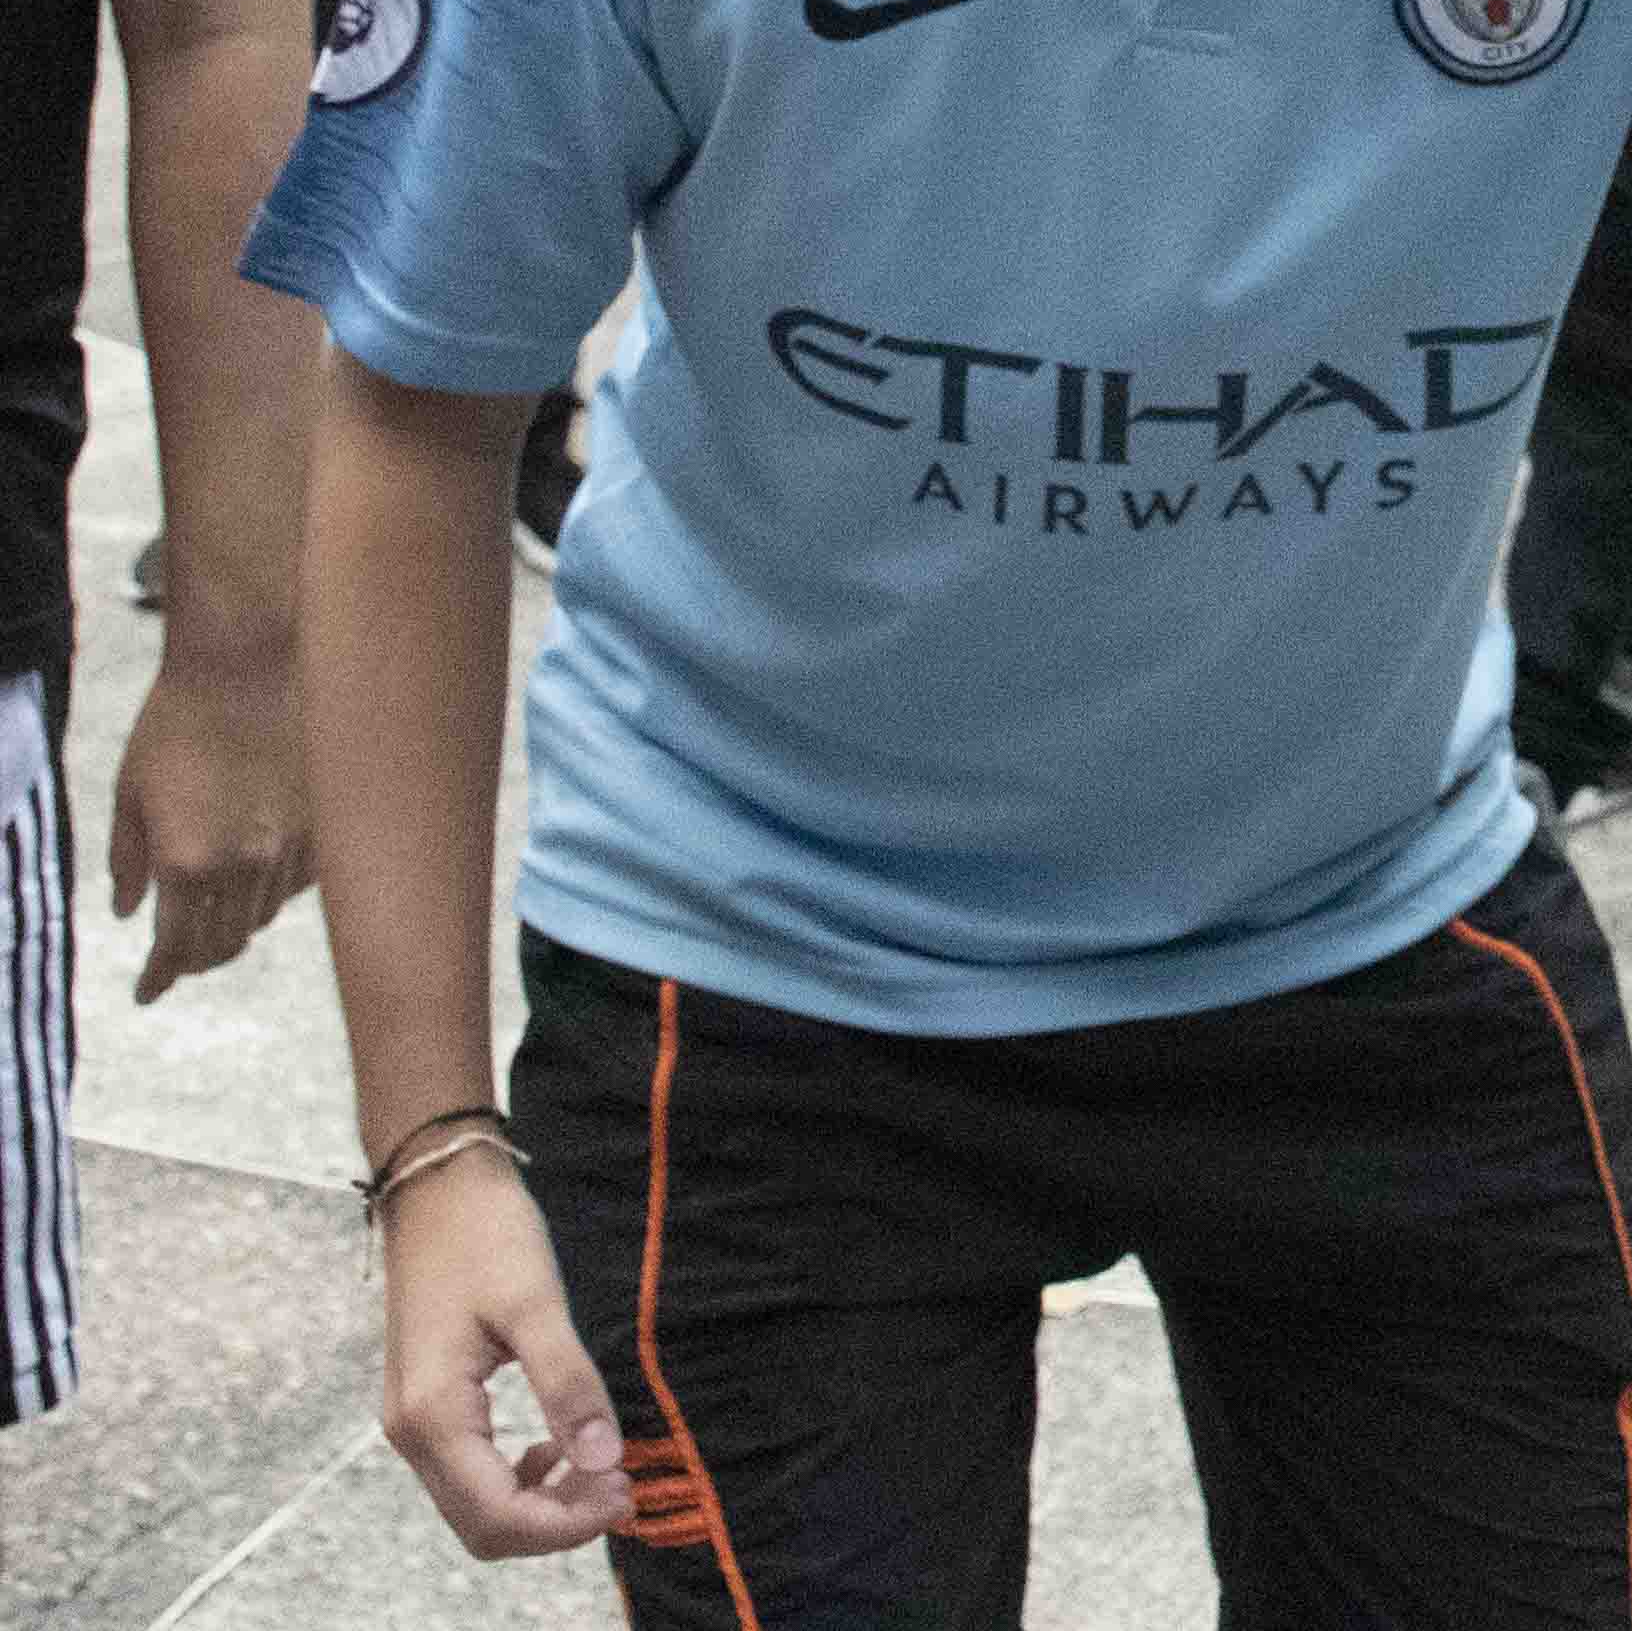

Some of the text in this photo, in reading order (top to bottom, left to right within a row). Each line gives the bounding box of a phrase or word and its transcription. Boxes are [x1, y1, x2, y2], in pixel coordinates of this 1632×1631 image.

[1482, 40, 1530, 61] CITY
[765, 306, 1557, 466] ETIHAD
[911, 457, 1420, 536] AIRWAYS
